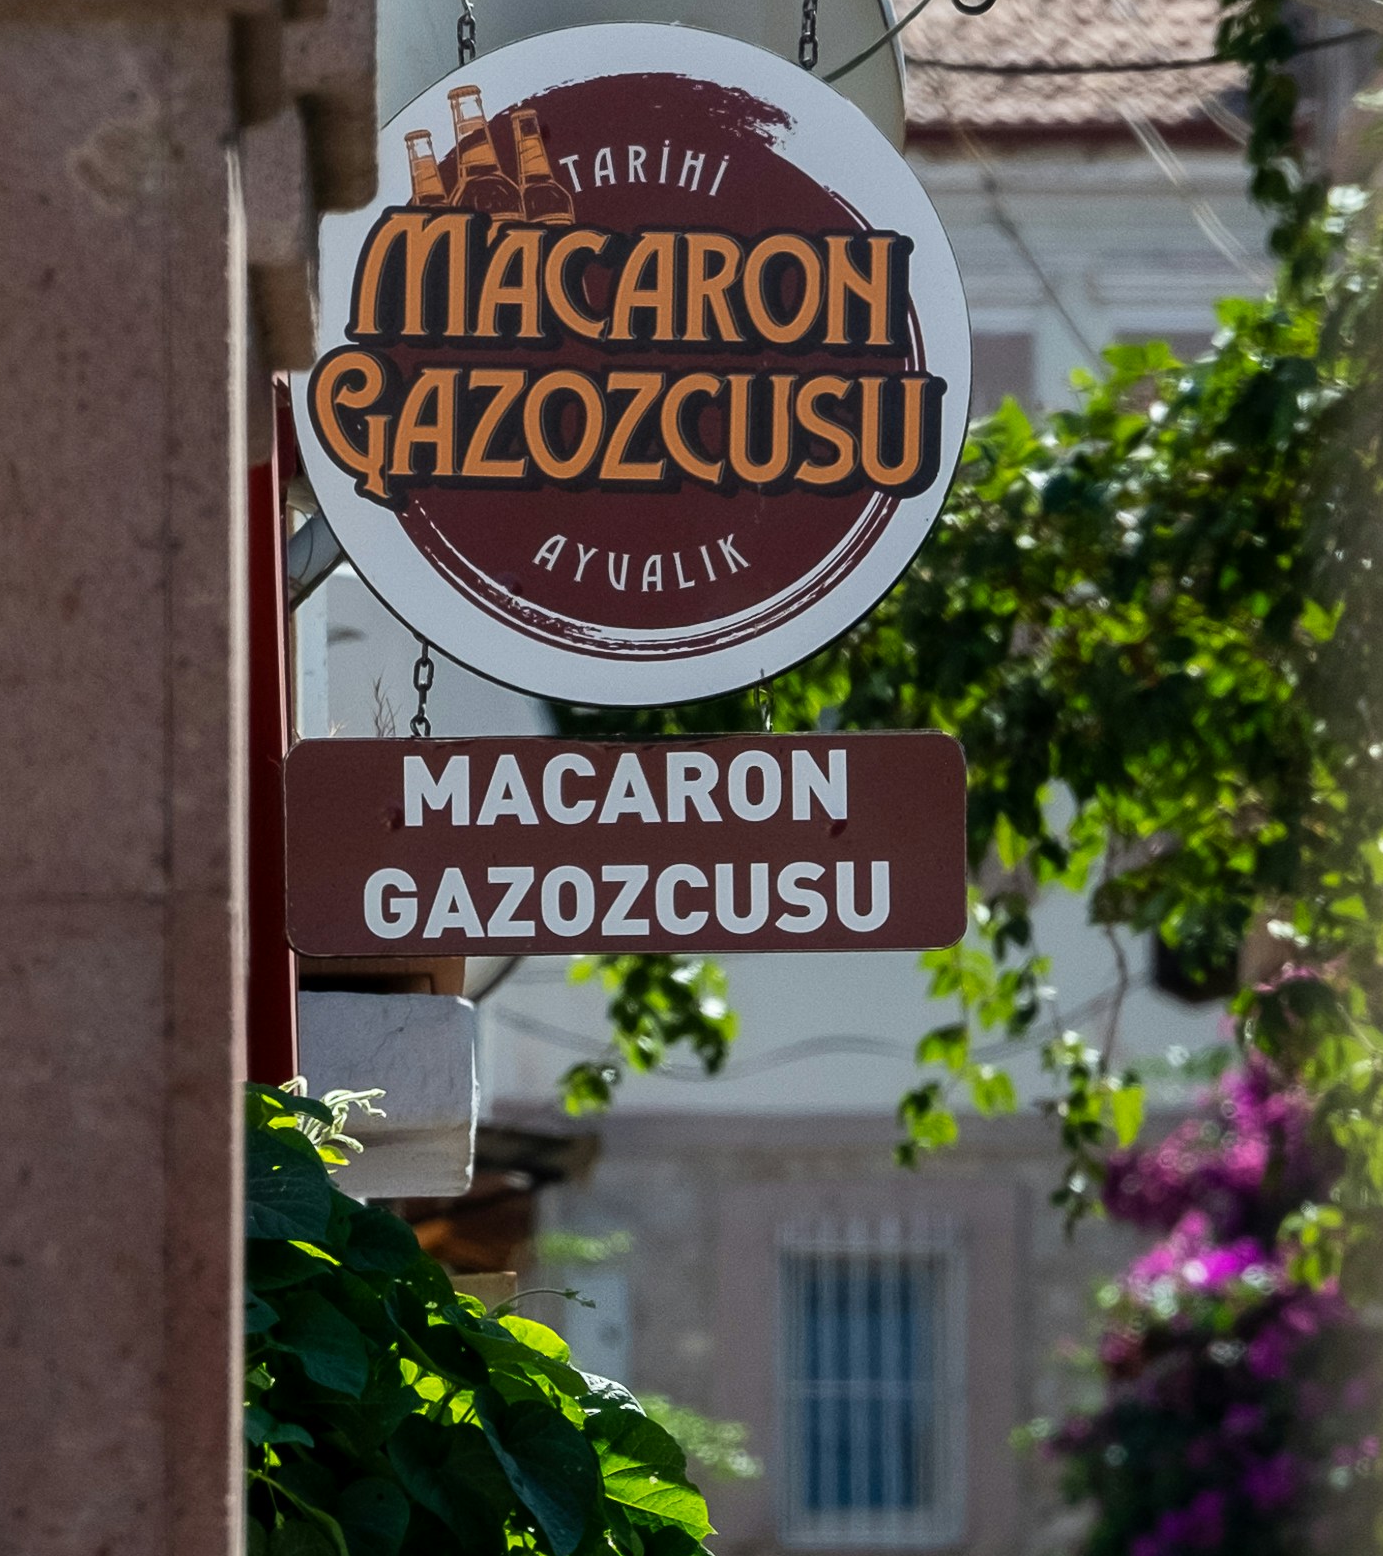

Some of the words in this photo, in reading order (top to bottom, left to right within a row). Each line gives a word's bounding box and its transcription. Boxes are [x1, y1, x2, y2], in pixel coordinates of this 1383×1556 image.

[559, 139, 730, 197] TARİHİ
[353, 211, 901, 347] MACARON
[315, 351, 936, 497] GAZOZCUSU
[403, 748, 849, 827] MACARON
[362, 859, 891, 940] GAZOZCUSU
